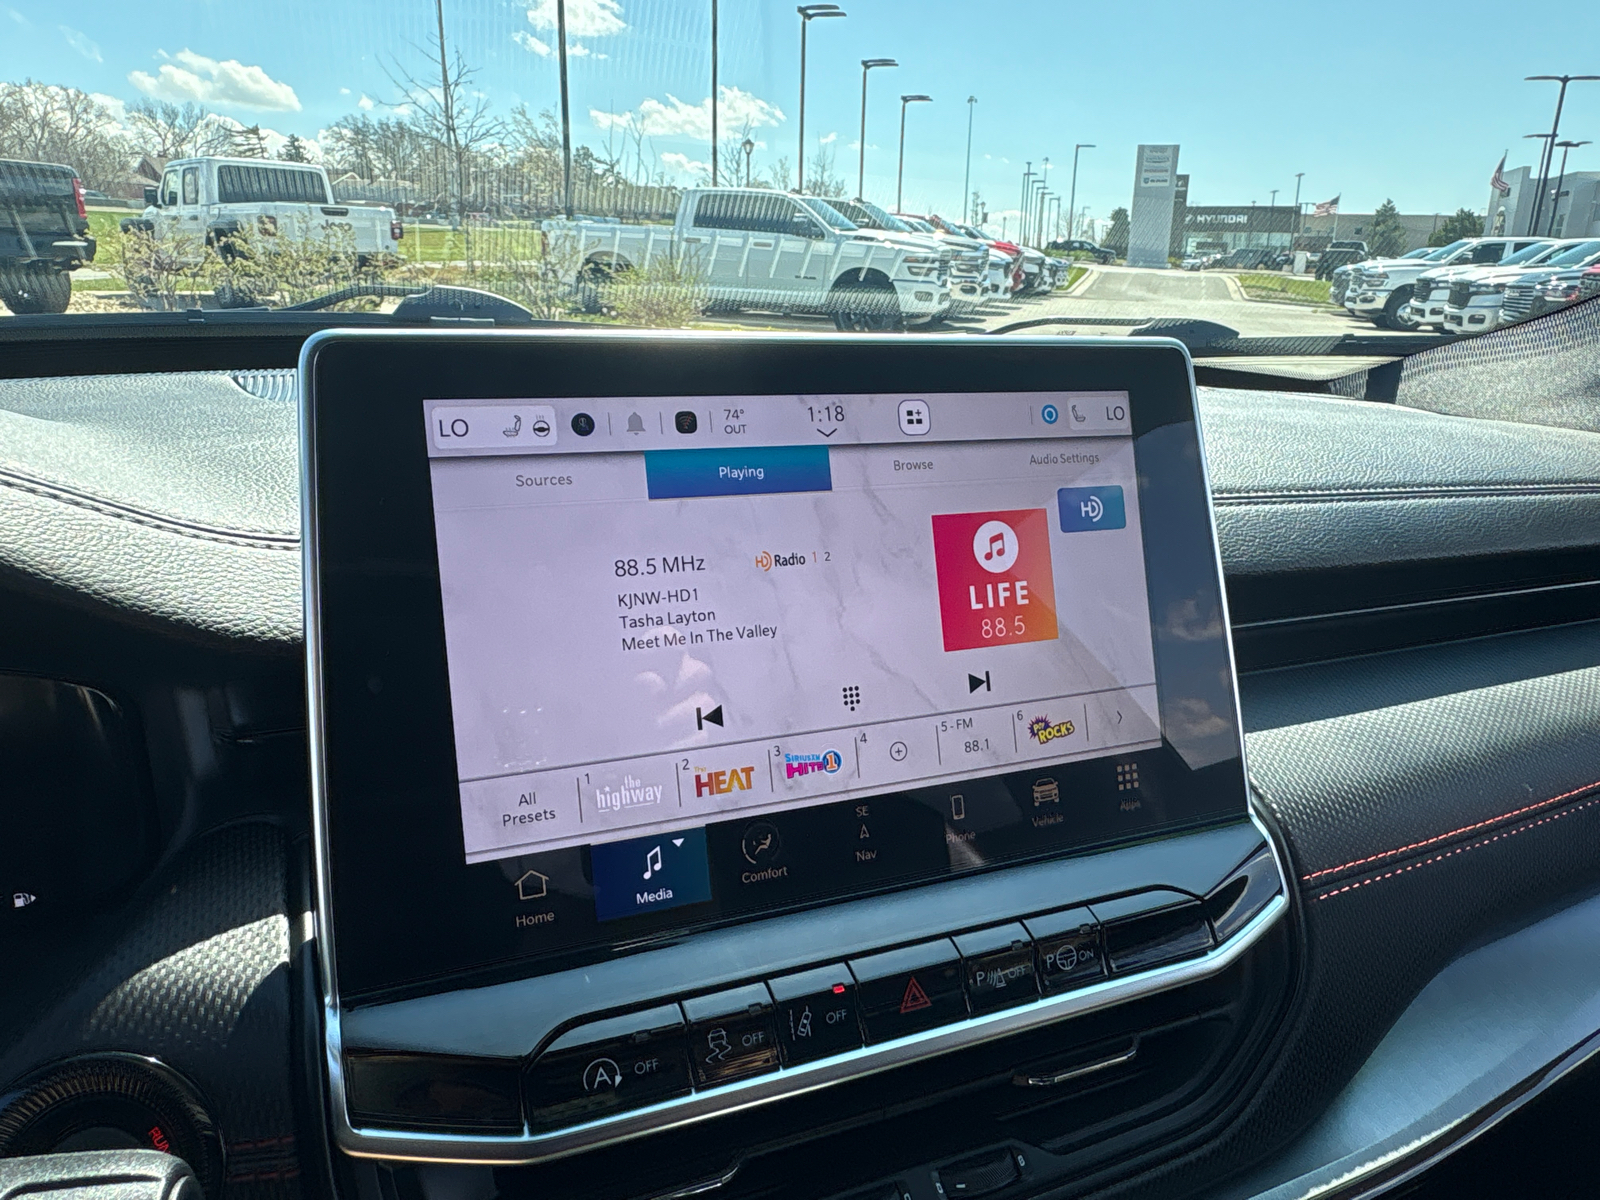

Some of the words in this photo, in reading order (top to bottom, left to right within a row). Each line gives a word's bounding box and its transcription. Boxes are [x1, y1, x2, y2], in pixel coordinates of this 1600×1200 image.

[1197, 214, 1248, 224] HYUNDAI
[807, 405, 845, 423] 1:18
[1106, 405, 1125, 422] LO
[439, 418, 469, 438] LO
[724, 424, 747, 435] OUT
[893, 459, 934, 472] Browse
[1029, 453, 1058, 466] Audio
[1060, 452, 1100, 467] Settings
[515, 473, 573, 488] Sources
[718, 466, 765, 481] Playing
[614, 557, 657, 577] 88.5
[662, 555, 706, 574] MHz
[774, 552, 806, 567] Radio
[617, 588, 699, 609] KJNW-HD1
[969, 580, 1029, 610] LIFE
[619, 613, 664, 629] Tasha
[668, 609, 716, 628] Layton
[981, 615, 1026, 639] 88.5
[622, 635, 660, 651] Meet
[664, 633, 686, 647] Me
[690, 631, 704, 644] In
[706, 628, 734, 642] The
[736, 624, 778, 640] Valley
[1016, 710, 1024, 721] 6
[860, 732, 868, 744] 4
[1038, 721, 1074, 743] ROCKS
[773, 745, 781, 757] 3
[964, 738, 989, 753] 88.1
[682, 758, 690, 770] 2
[786, 761, 824, 779] HITS
[584, 773, 590, 785] 1
[624, 774, 641, 789] the
[694, 766, 755, 798] HEAT
[518, 791, 537, 807] All
[595, 785, 663, 811] highway
[502, 808, 556, 827] Presets
[855, 805, 869, 817] SE
[1031, 812, 1064, 828] Vehicle
[945, 831, 976, 845] Phone
[855, 849, 877, 862] Nav
[741, 866, 788, 884] Comfort
[636, 887, 673, 905] Media
[515, 911, 555, 928] Home
[1079, 949, 1094, 961] ON
[1007, 965, 1027, 979] OFF
[825, 1009, 847, 1024] OFF
[741, 1031, 765, 1047] OFF
[634, 1058, 660, 1076] OFF
